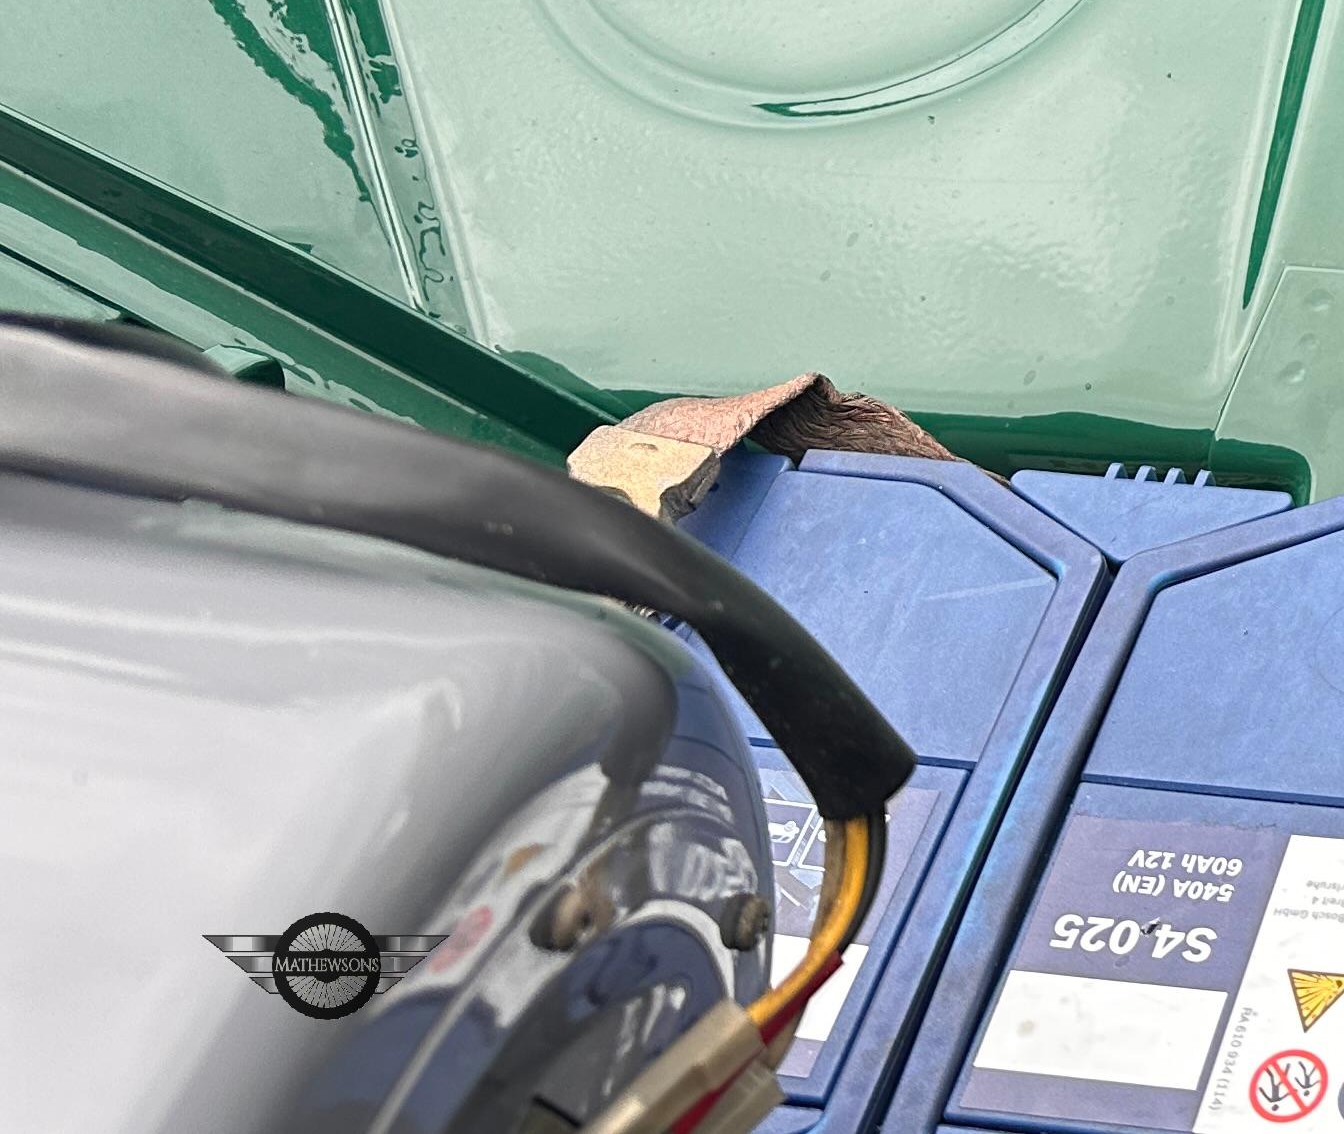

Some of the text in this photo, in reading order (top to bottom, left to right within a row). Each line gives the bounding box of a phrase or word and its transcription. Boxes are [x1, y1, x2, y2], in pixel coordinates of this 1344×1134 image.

[1127, 849, 1243, 877] 60Ah 12V
[1112, 870, 1235, 902] 540A (EN)
[1273, 906, 1309, 919] GmbH
[1311, 895, 1319, 905] 4
[1221, 1051, 1238, 1075] 934
[1208, 1078, 1231, 1111] (114)
